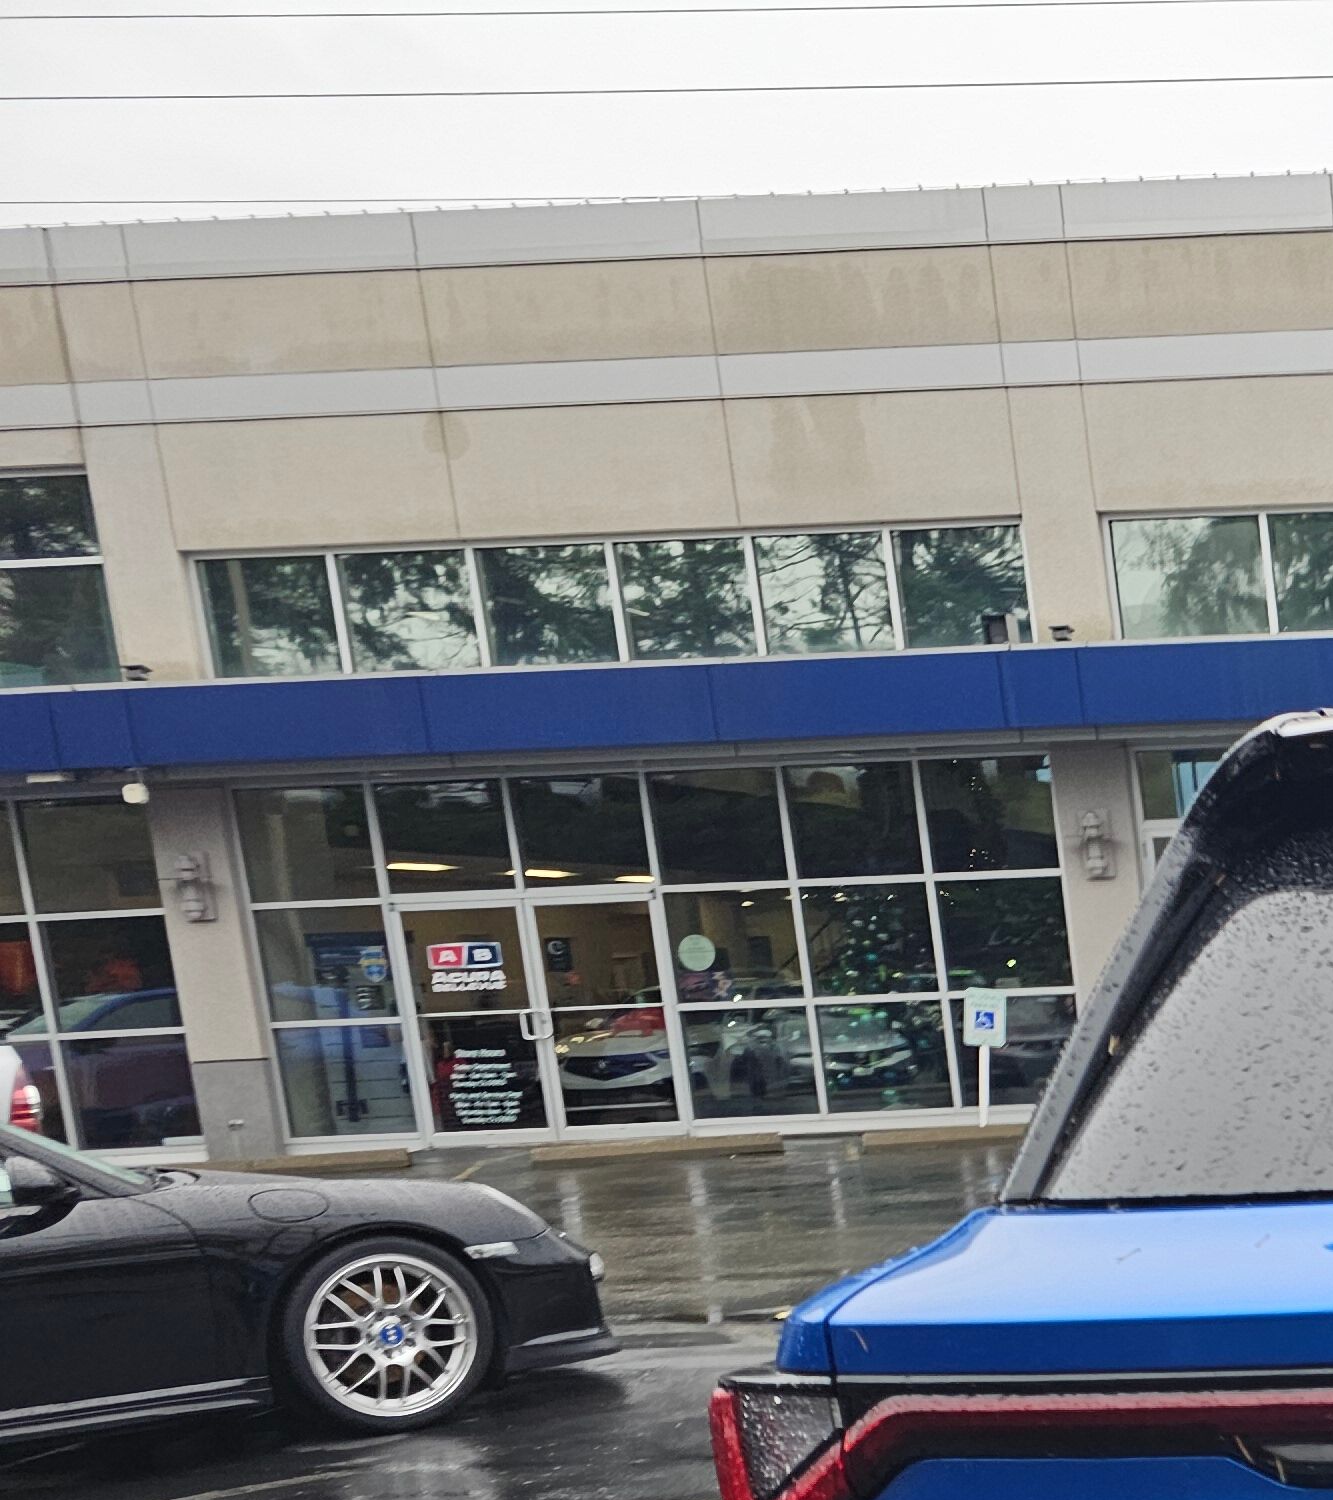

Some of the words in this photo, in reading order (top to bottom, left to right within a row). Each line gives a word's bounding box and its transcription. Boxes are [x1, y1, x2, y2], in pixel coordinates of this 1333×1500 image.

[438, 949, 458, 963] A
[472, 948, 493, 962] B
[431, 969, 507, 984] ACURA
